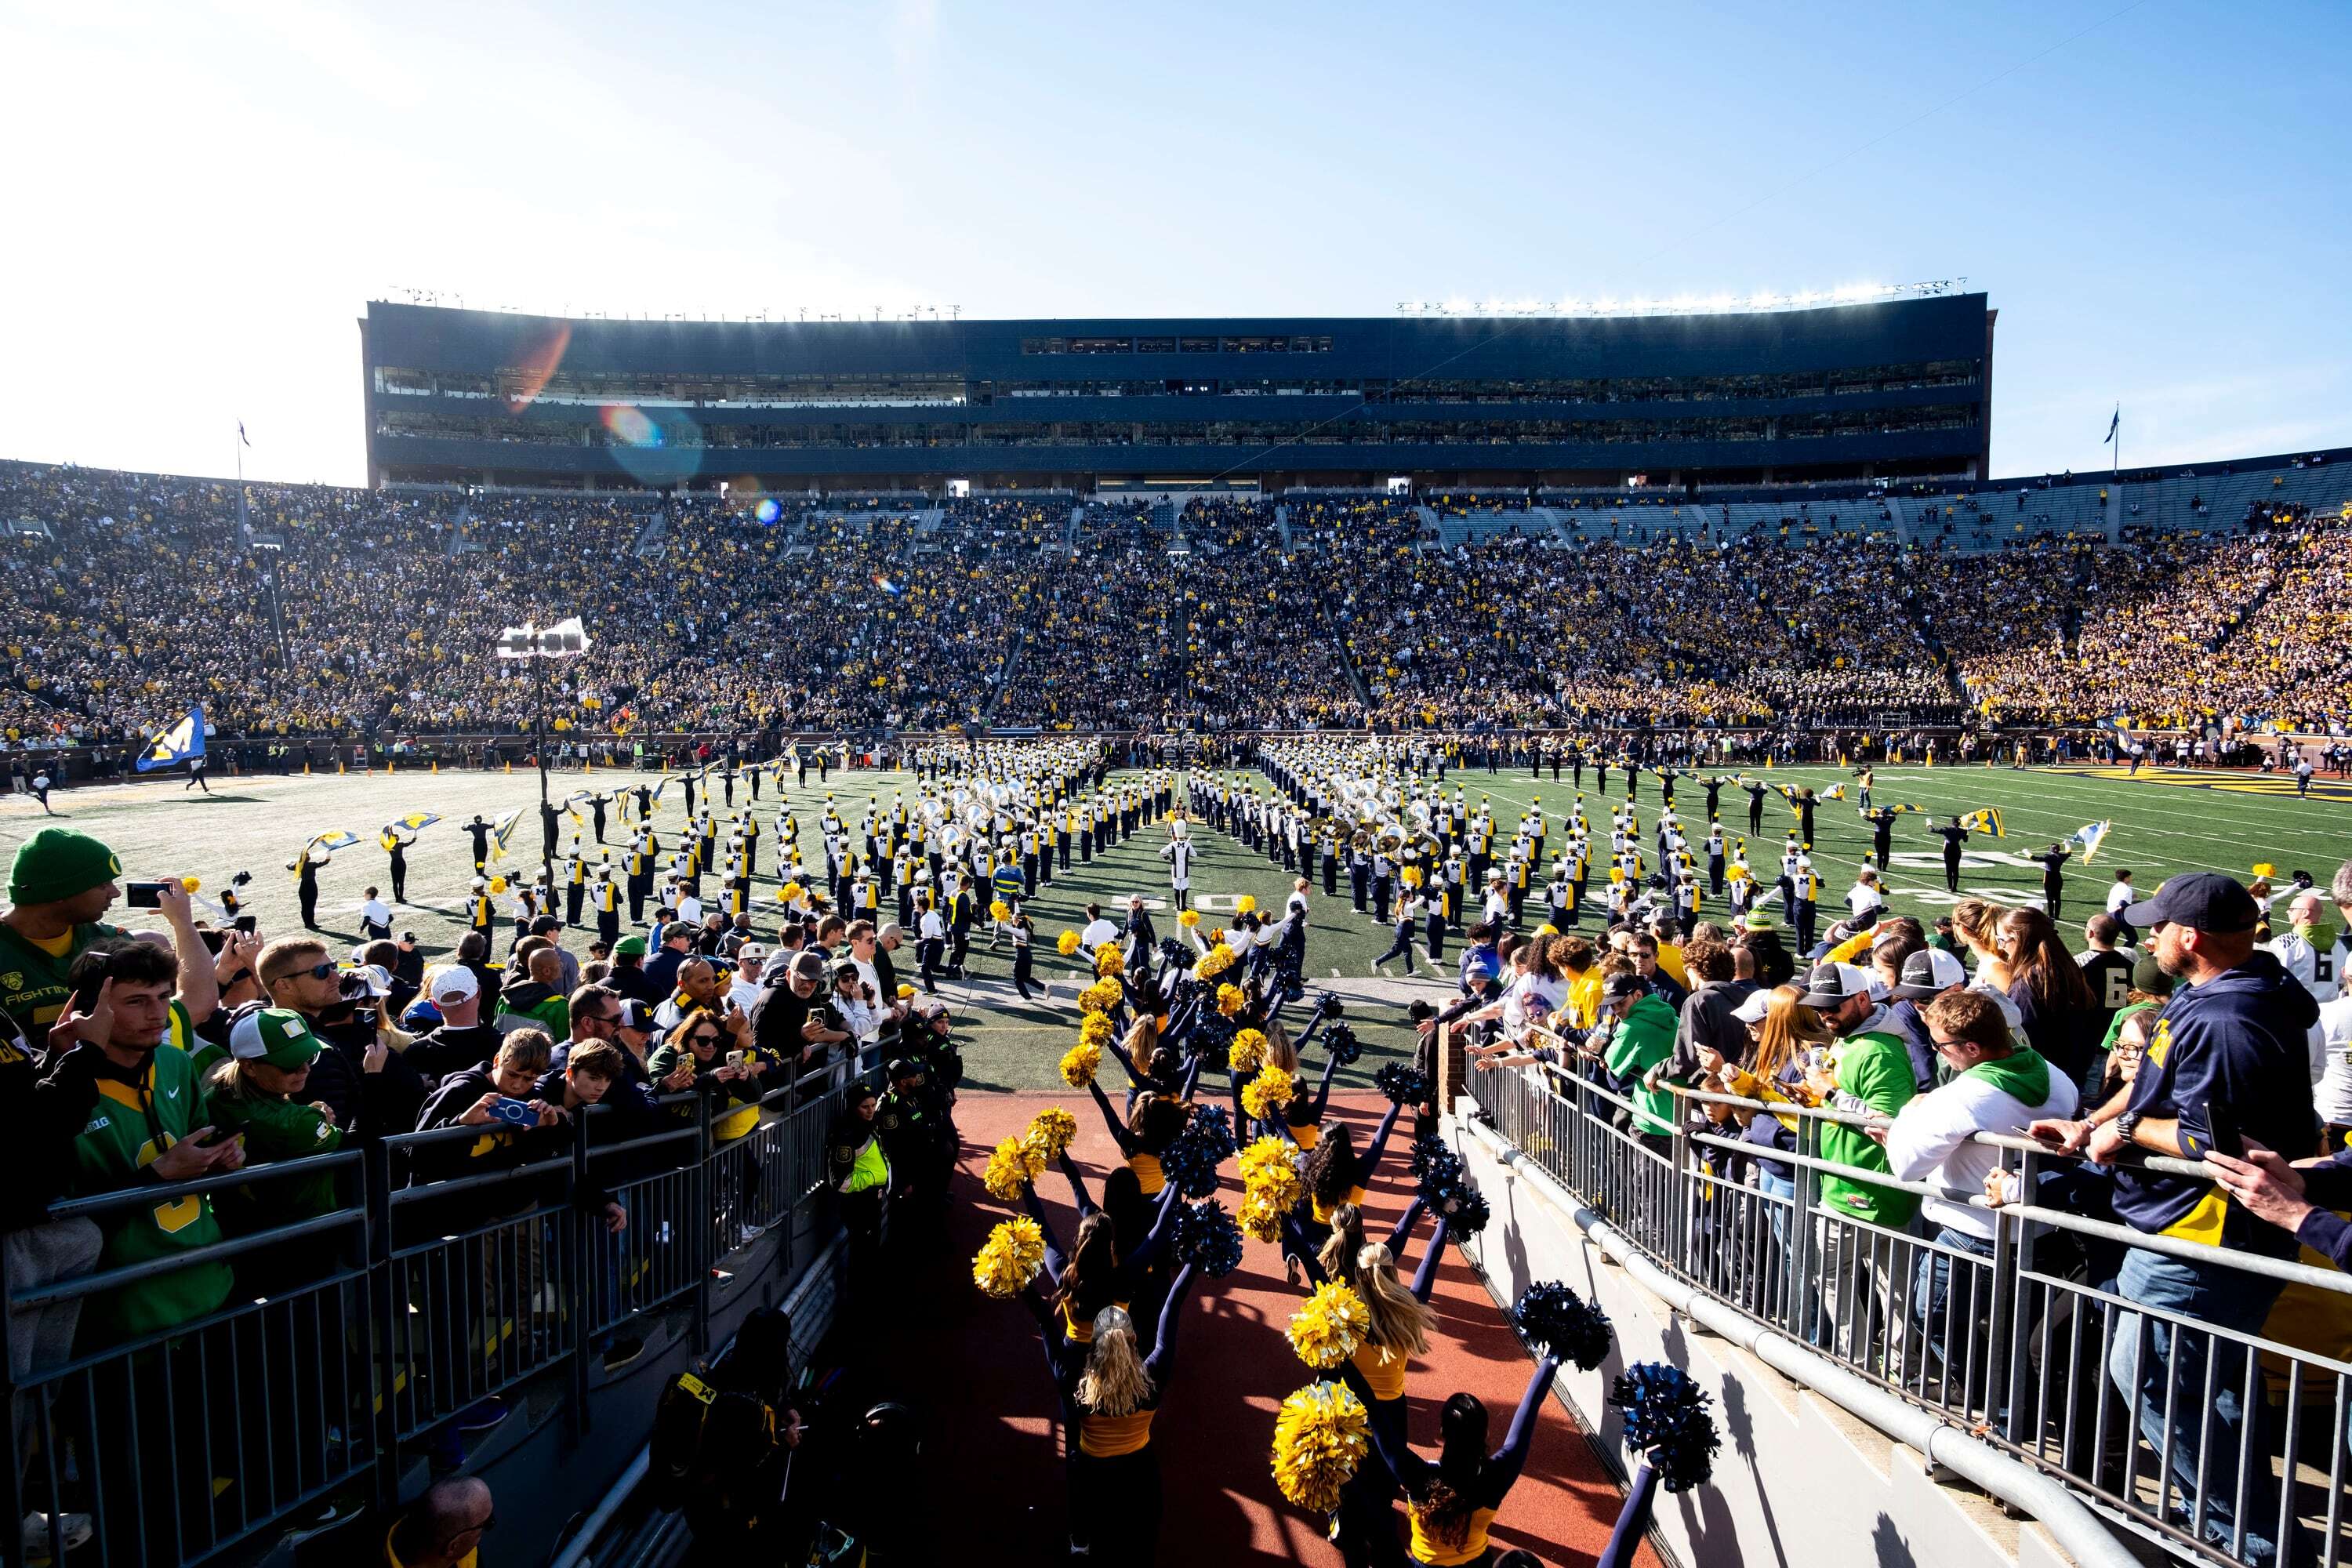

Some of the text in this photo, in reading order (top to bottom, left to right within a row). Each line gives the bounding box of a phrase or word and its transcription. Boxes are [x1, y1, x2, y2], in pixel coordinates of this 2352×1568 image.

[715, 967, 729, 982] M
[2313, 949, 2334, 982] 6
[2104, 967, 2128, 1008] 6
[644, 1007, 653, 1017] M
